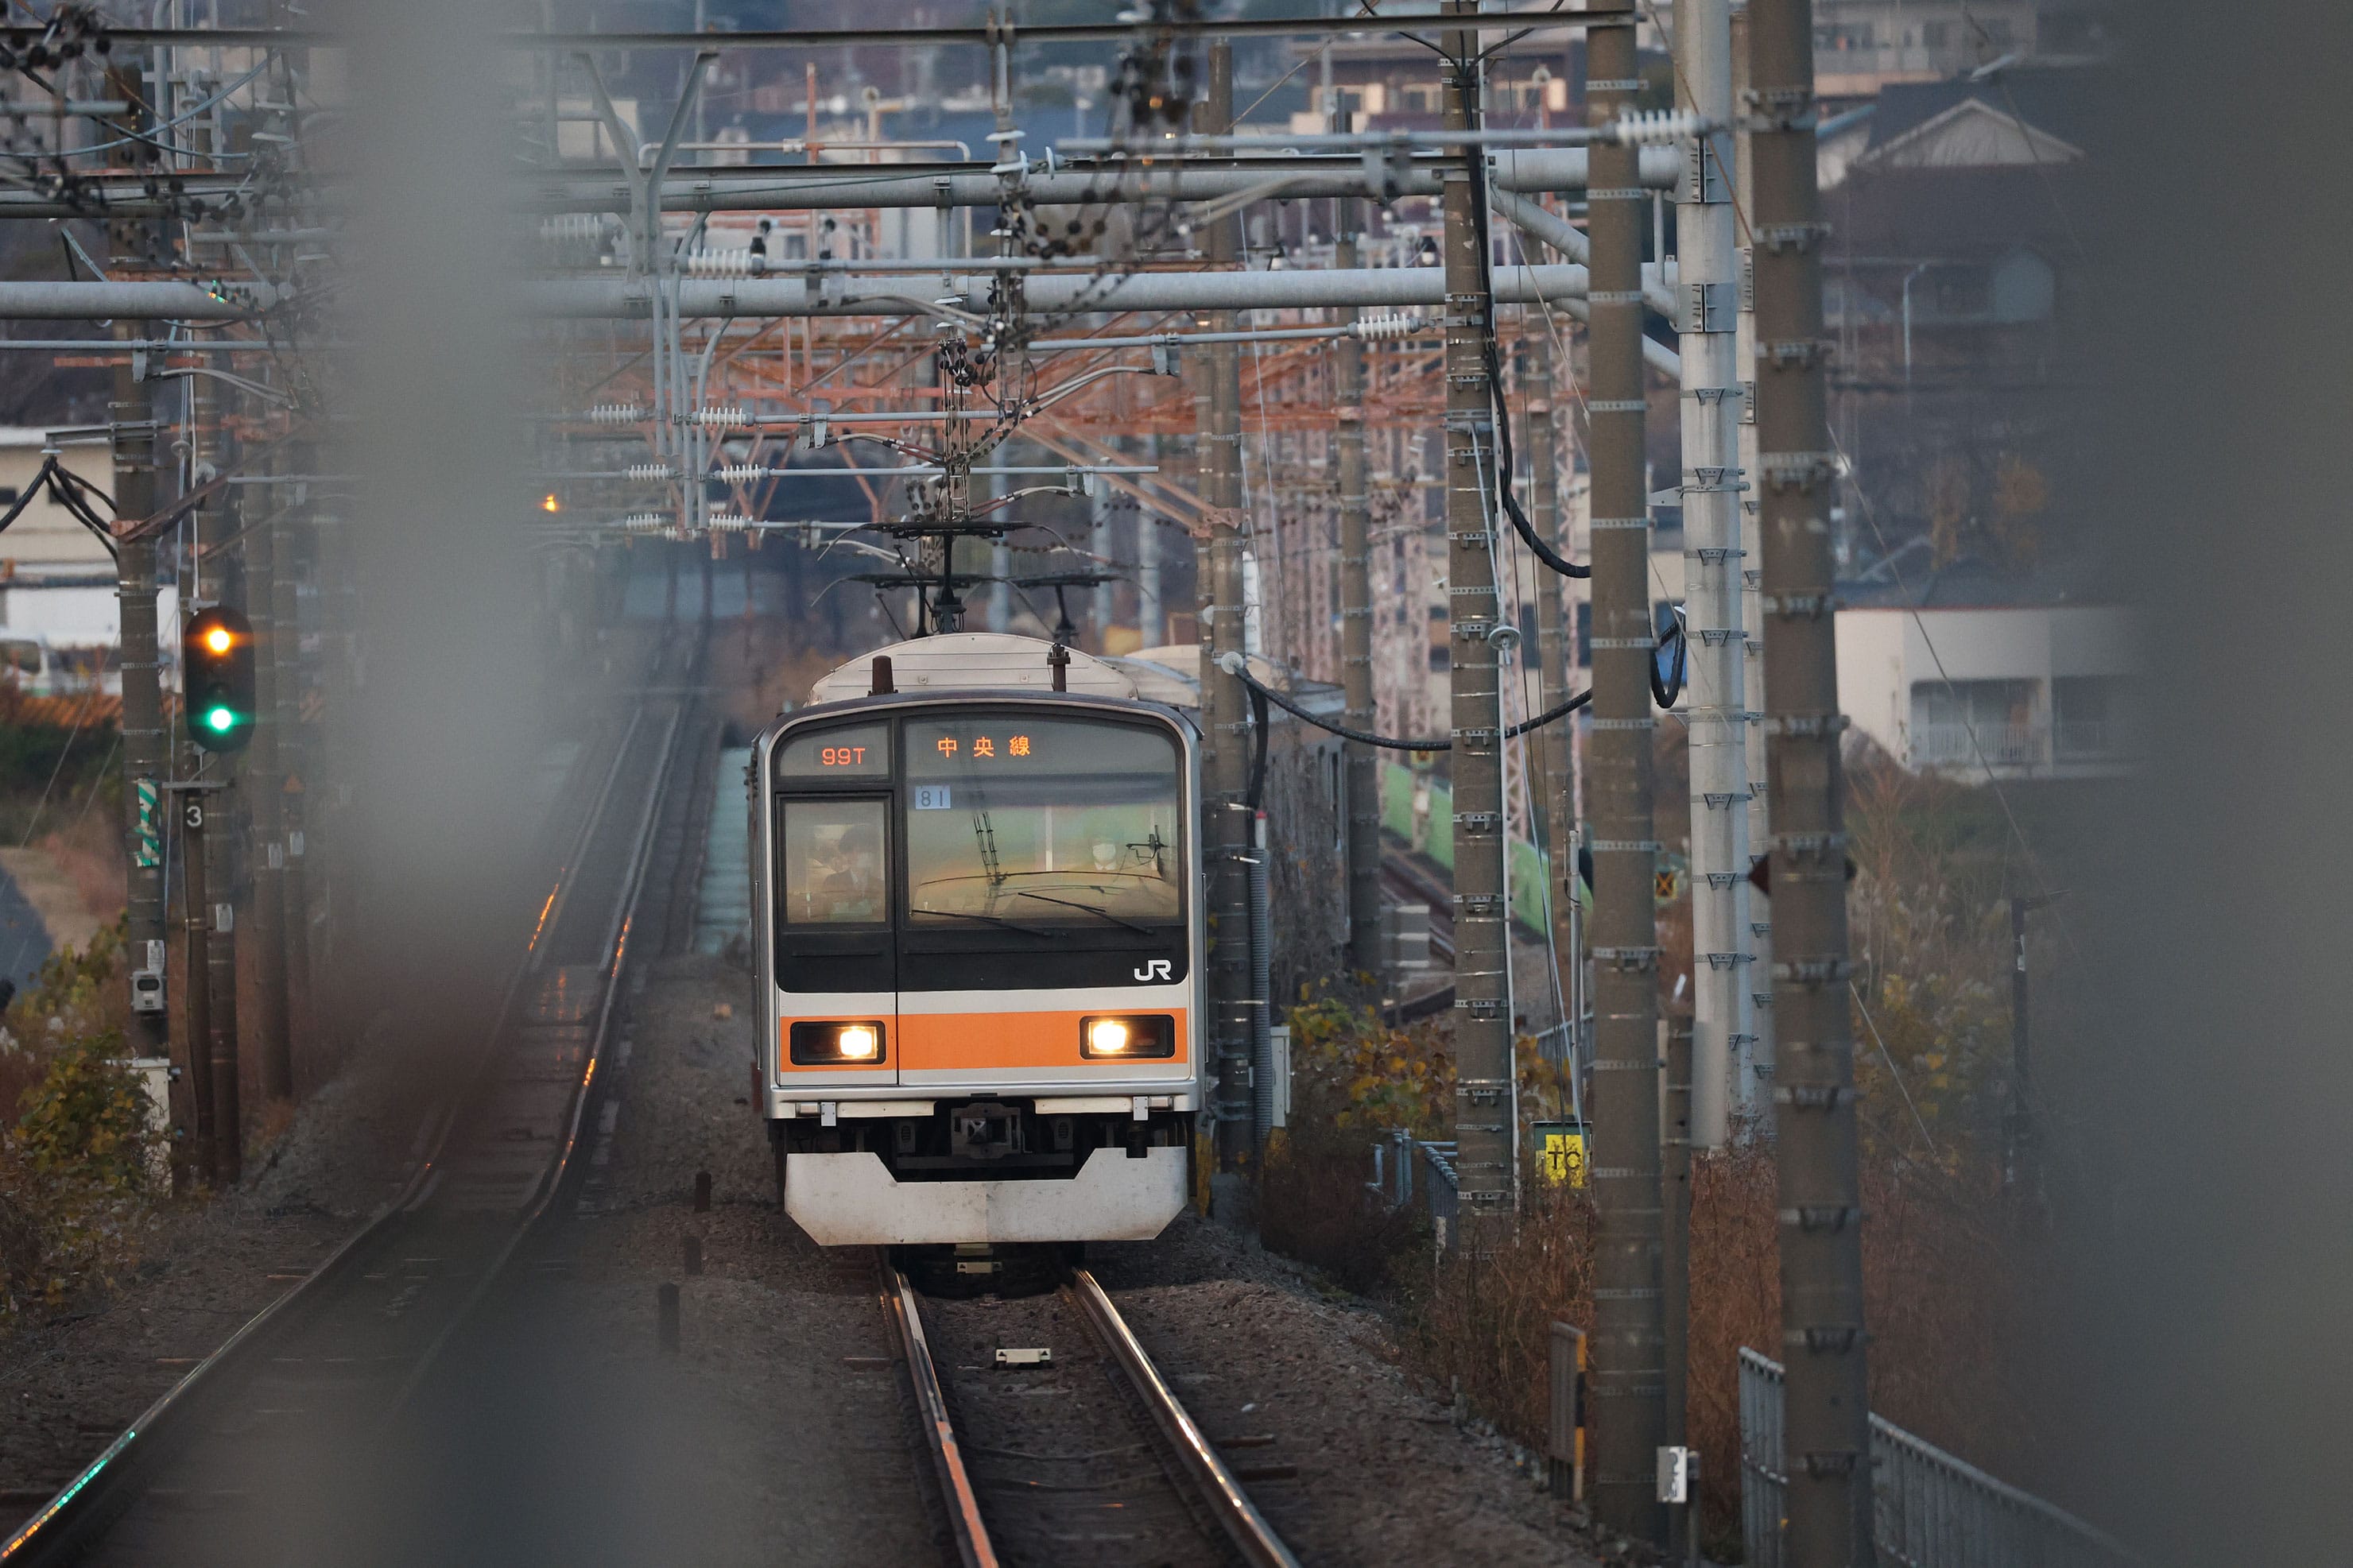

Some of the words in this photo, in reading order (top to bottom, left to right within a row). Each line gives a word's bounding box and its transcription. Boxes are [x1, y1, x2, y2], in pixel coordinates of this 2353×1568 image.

[822, 748, 865, 765] 99T
[937, 736, 1030, 758] 中央線
[921, 791, 944, 807] 81
[187, 806, 202, 827] 3
[1134, 959, 1171, 981] JR
[1548, 1151, 1580, 1170] TC
